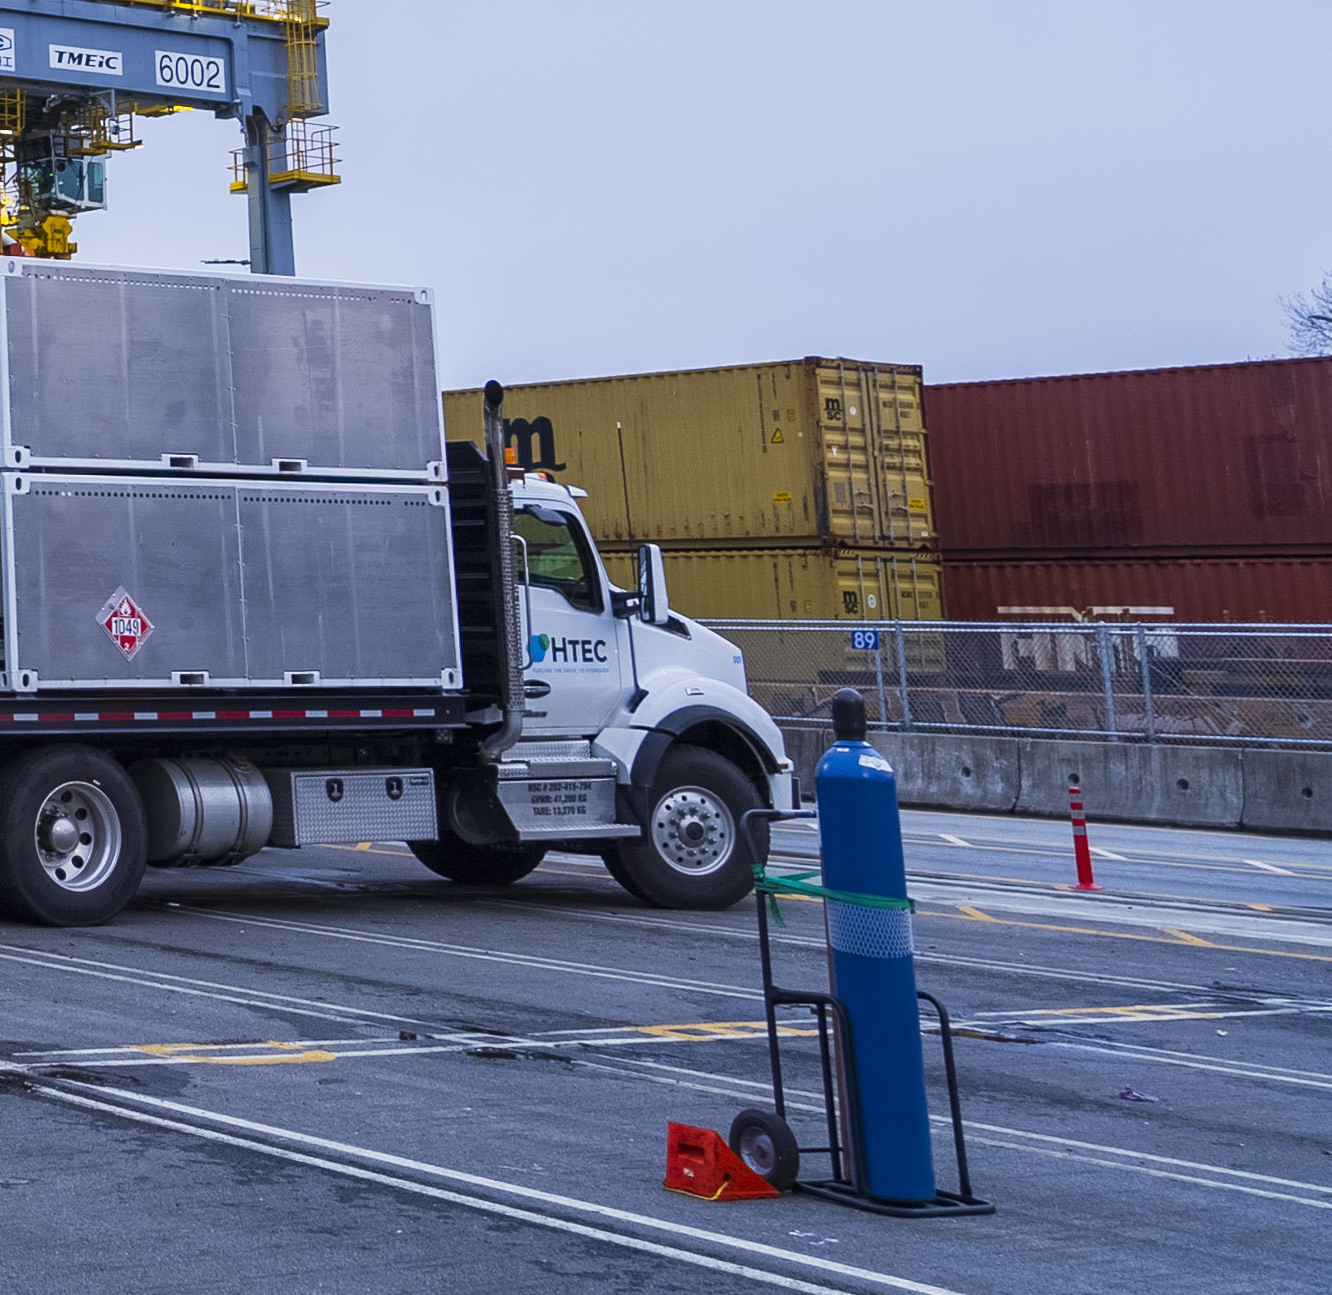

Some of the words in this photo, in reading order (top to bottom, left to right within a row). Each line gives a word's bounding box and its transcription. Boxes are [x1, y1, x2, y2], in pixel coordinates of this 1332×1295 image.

[159, 54, 221, 89] 6002
[113, 618, 139, 635] 1049
[854, 632, 876, 649] 89
[551, 636, 608, 663] HTEC
[578, 794, 587, 803] KG
[533, 807, 552, 816] TARE:
[577, 805, 586, 815] KG
